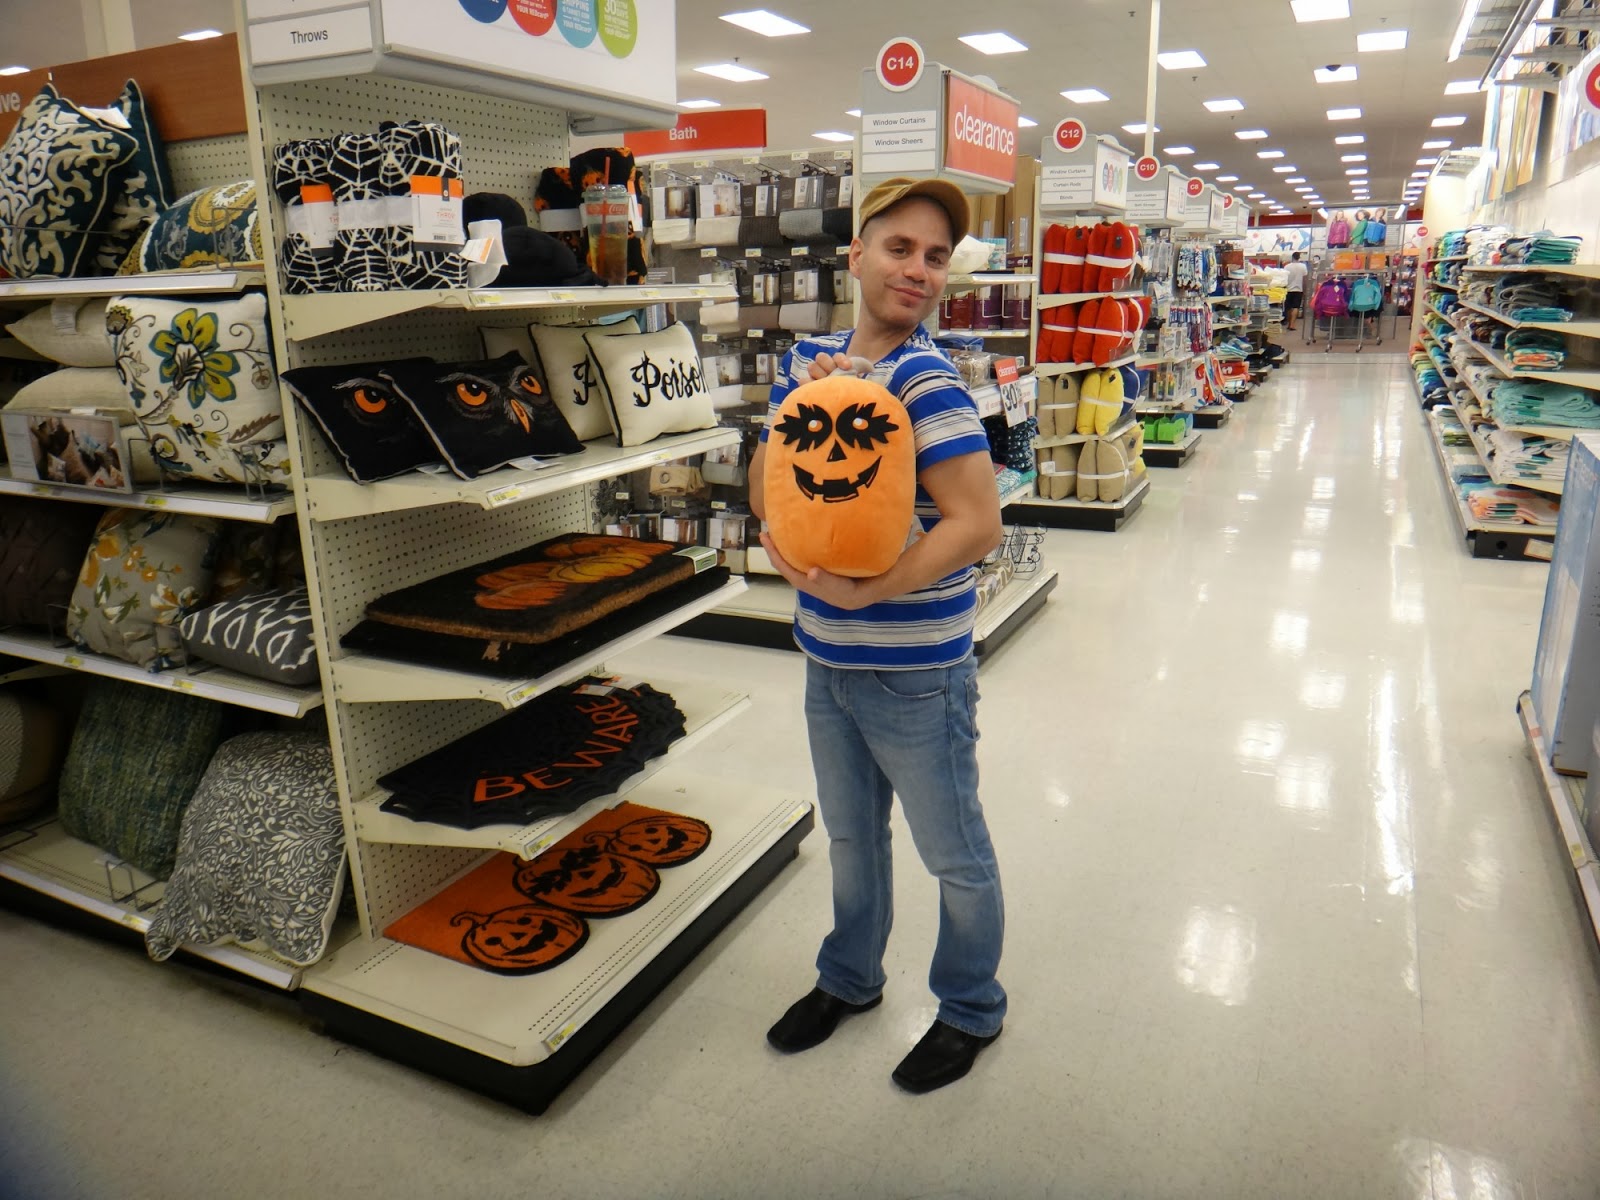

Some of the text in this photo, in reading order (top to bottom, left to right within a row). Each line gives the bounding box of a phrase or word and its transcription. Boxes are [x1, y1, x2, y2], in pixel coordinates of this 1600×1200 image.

[290, 30, 328, 44] Throws
[886, 56, 914, 71] C14
[872, 116, 926, 126] Window Curtains
[669, 126, 697, 141] Bath
[954, 104, 1014, 156] clearance
[1060, 129, 1080, 139] C12
[874, 137, 923, 146] Window Sheers
[1140, 163, 1155, 171] C10
[473, 695, 640, 803] BEWARE
